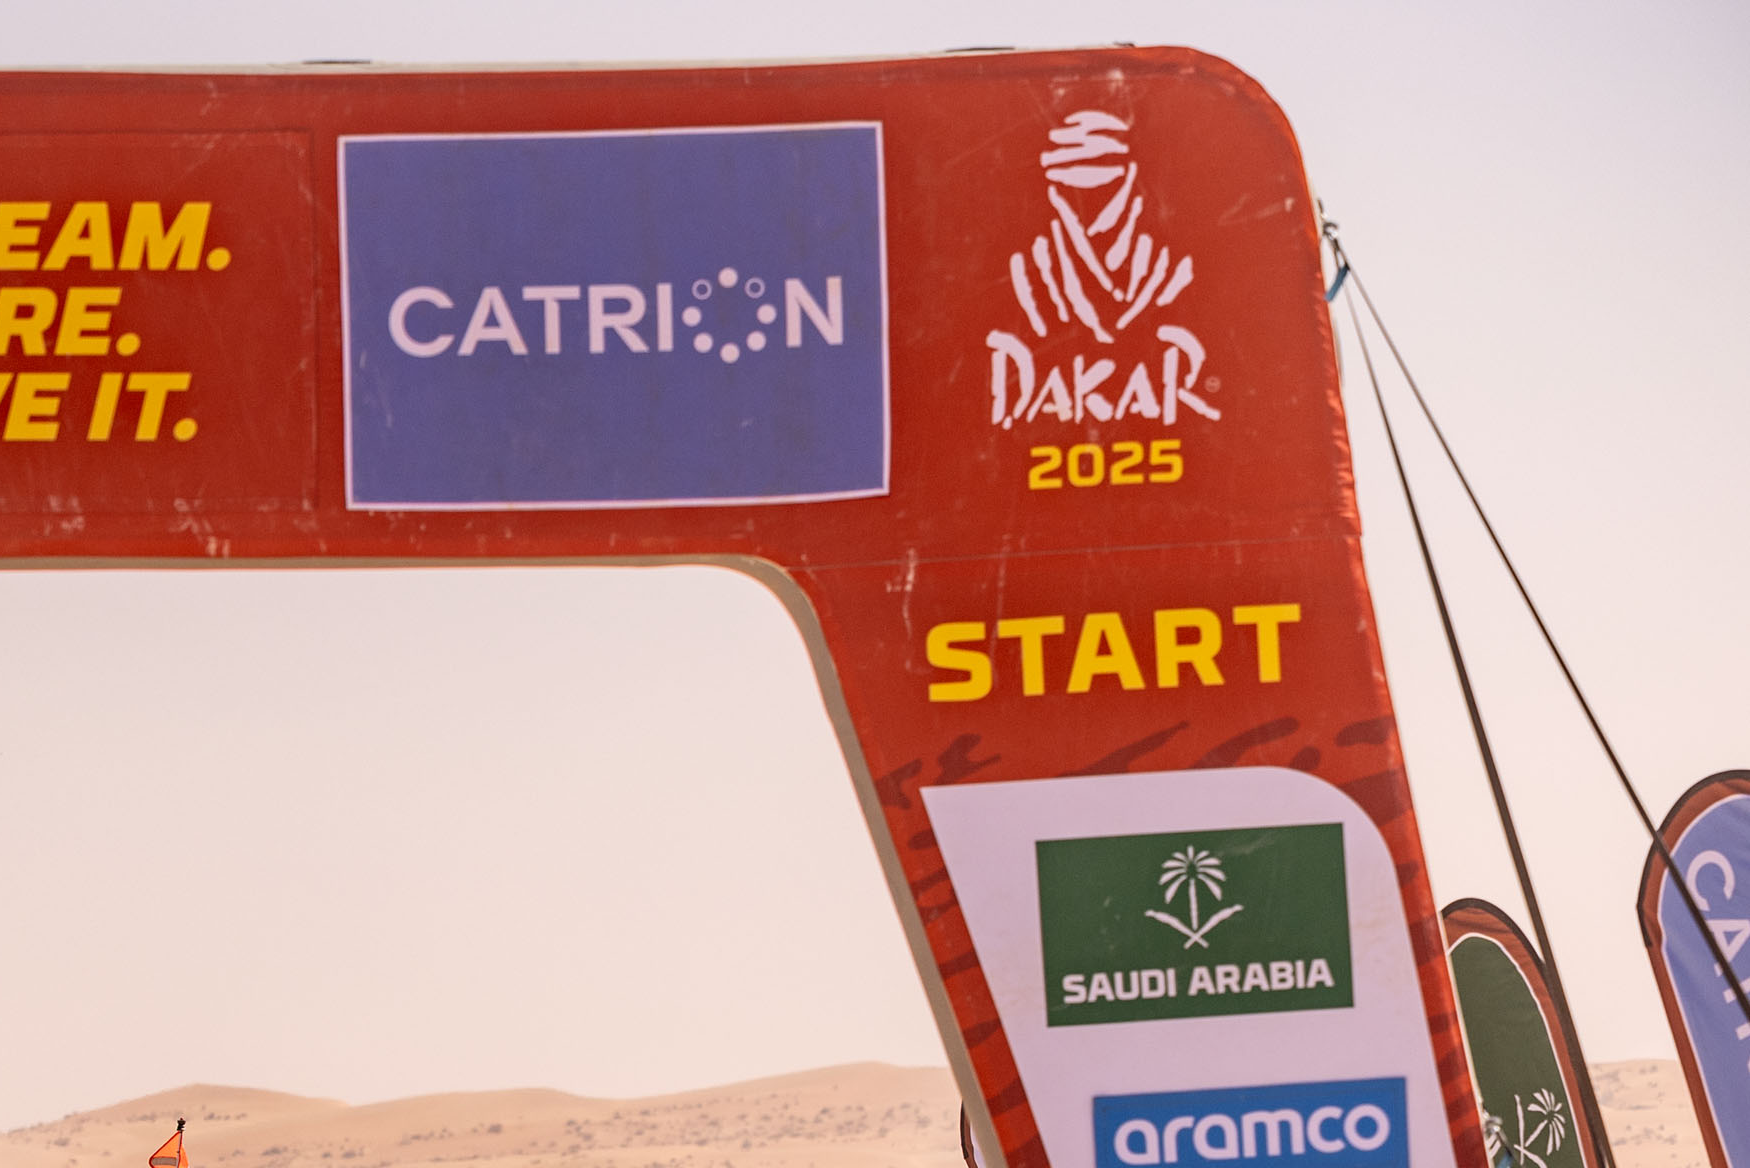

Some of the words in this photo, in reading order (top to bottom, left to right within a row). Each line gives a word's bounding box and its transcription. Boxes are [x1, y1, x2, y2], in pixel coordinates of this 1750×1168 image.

[388, 267, 844, 363] CATRION
[86, 372, 198, 441] IT.
[986, 326, 1220, 429] DAKAR
[1028, 439, 1185, 491] 2025
[926, 604, 1302, 702] START
[1062, 968, 1177, 1004] SAUDI
[1188, 958, 1334, 997] ARABIA
[1113, 1103, 1391, 1166] aramco
